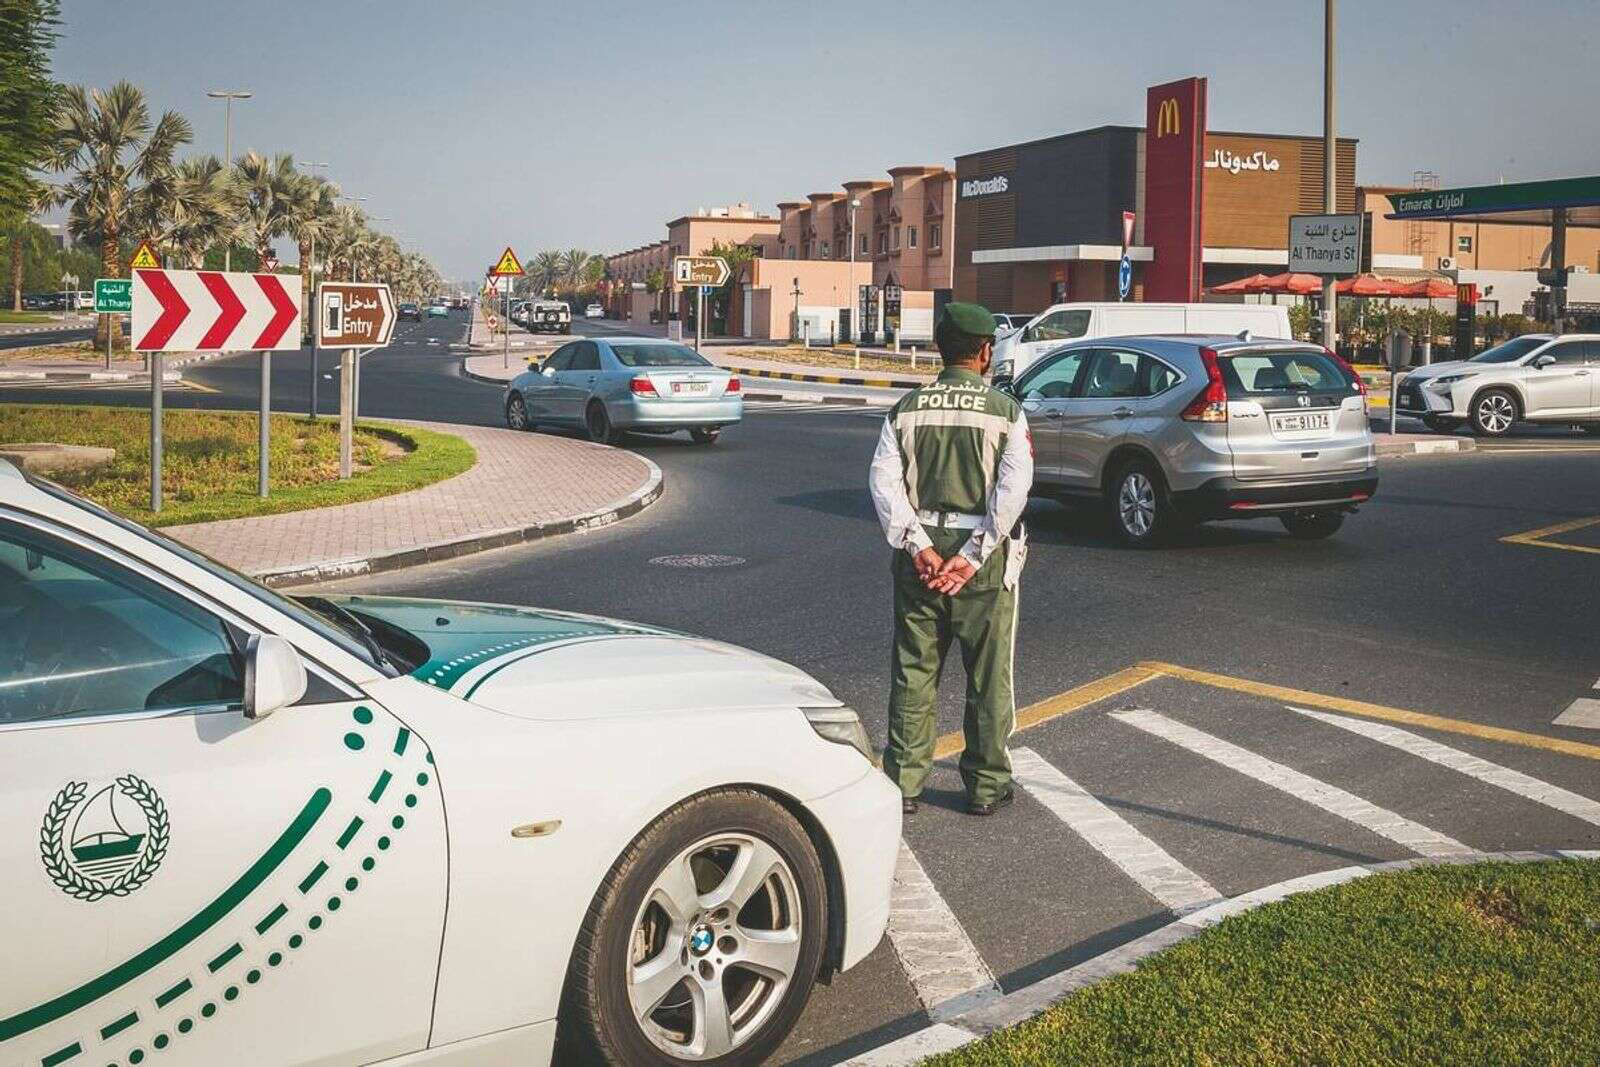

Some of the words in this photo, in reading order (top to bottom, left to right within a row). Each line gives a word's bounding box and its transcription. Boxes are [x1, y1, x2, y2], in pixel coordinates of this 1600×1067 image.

[1203, 149, 1280, 174] ماكدونال
[961, 176, 1008, 197] McDonald's
[1399, 198, 1432, 211] Emarat
[1331, 224, 1357, 242] شارع
[1292, 246, 1303, 260] Al
[1306, 246, 1341, 262] Thanya
[1344, 246, 1356, 260] St
[692, 272, 713, 283] Entry
[98, 299, 107, 307] Al
[108, 299, 132, 308] Thany
[344, 292, 378, 313] مدخل
[344, 317, 373, 337] Entry
[917, 394, 986, 411] POLICE
[1300, 415, 1329, 430] 91174
